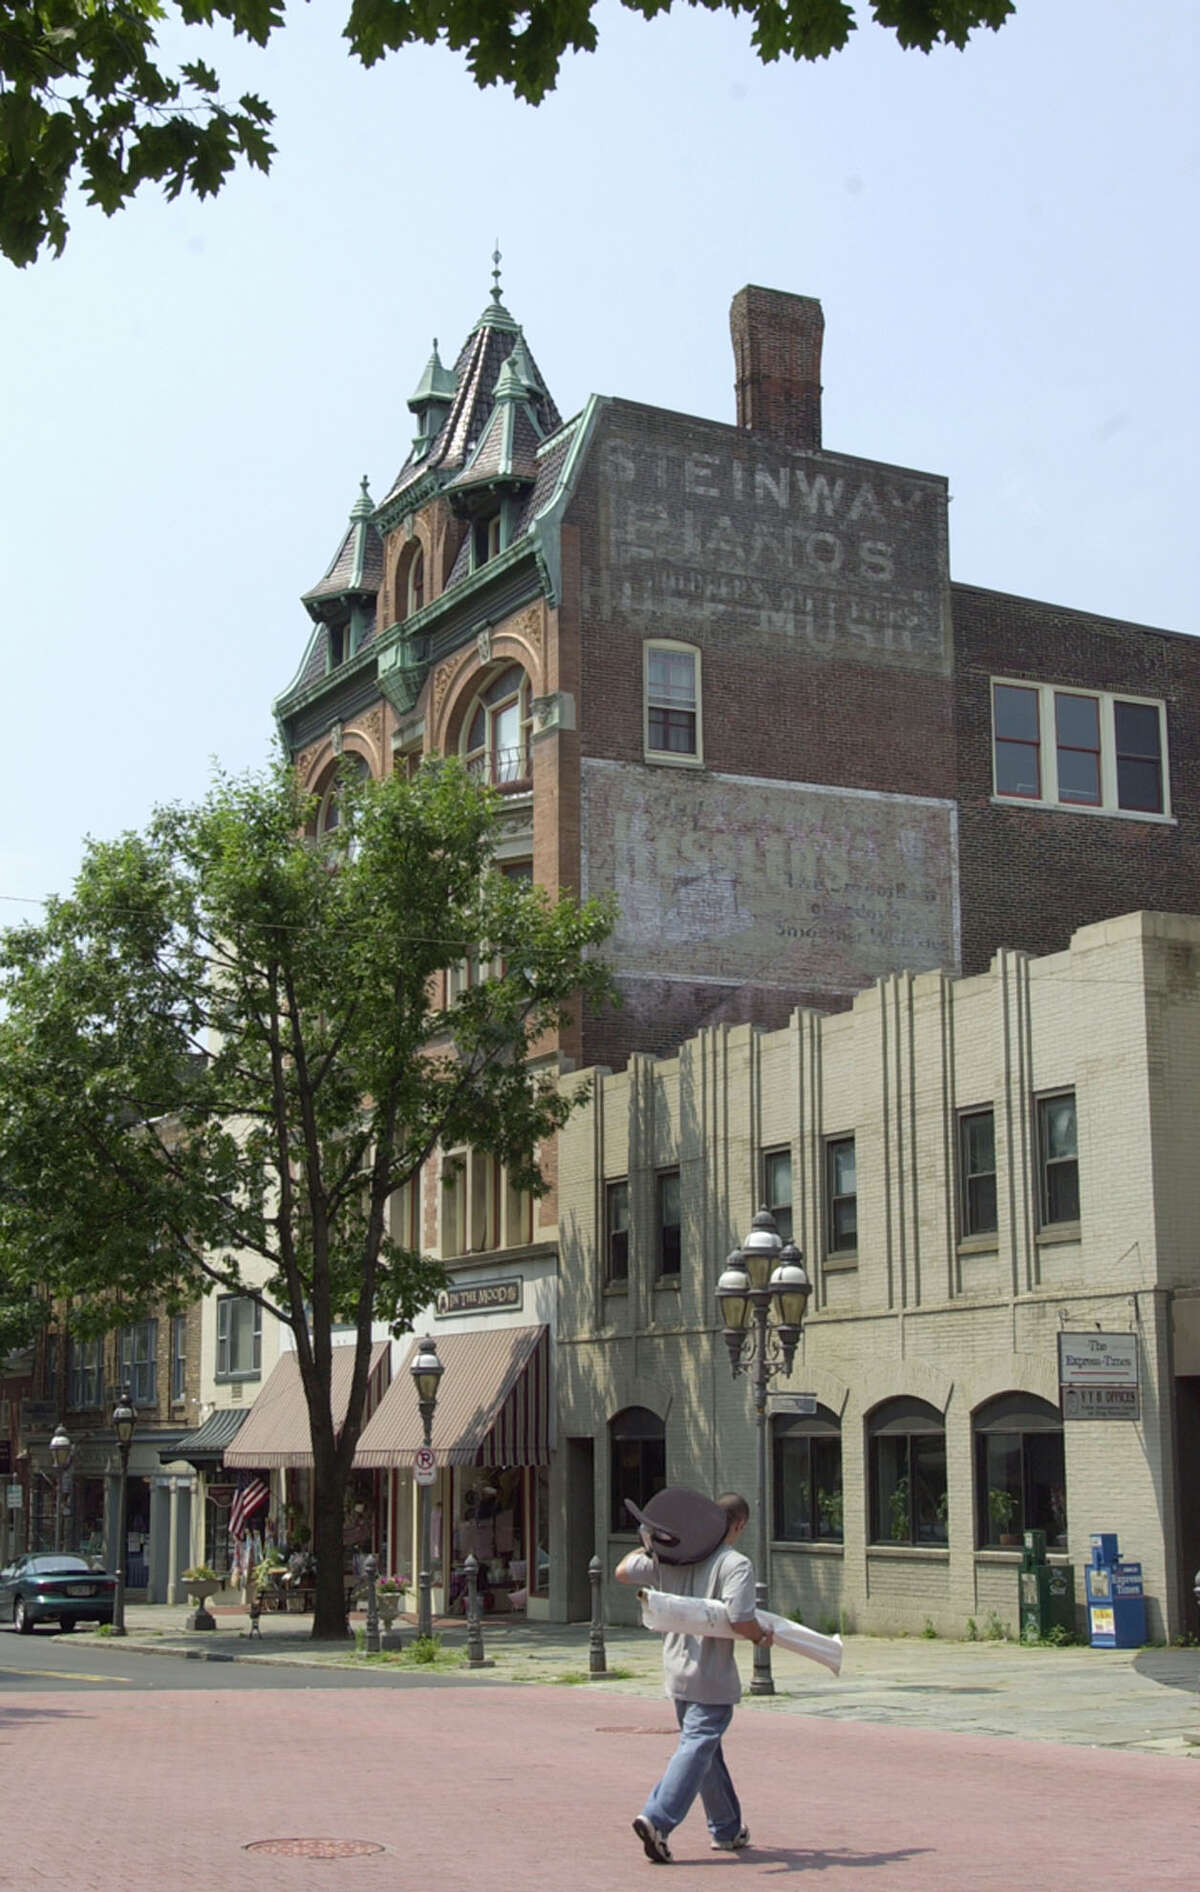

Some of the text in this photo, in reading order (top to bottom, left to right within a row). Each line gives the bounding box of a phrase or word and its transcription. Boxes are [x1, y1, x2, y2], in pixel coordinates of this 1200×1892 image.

[605, 438, 923, 526] STEINWAY
[624, 503, 896, 581] PIANOS
[1087, 1340, 1108, 1352] The
